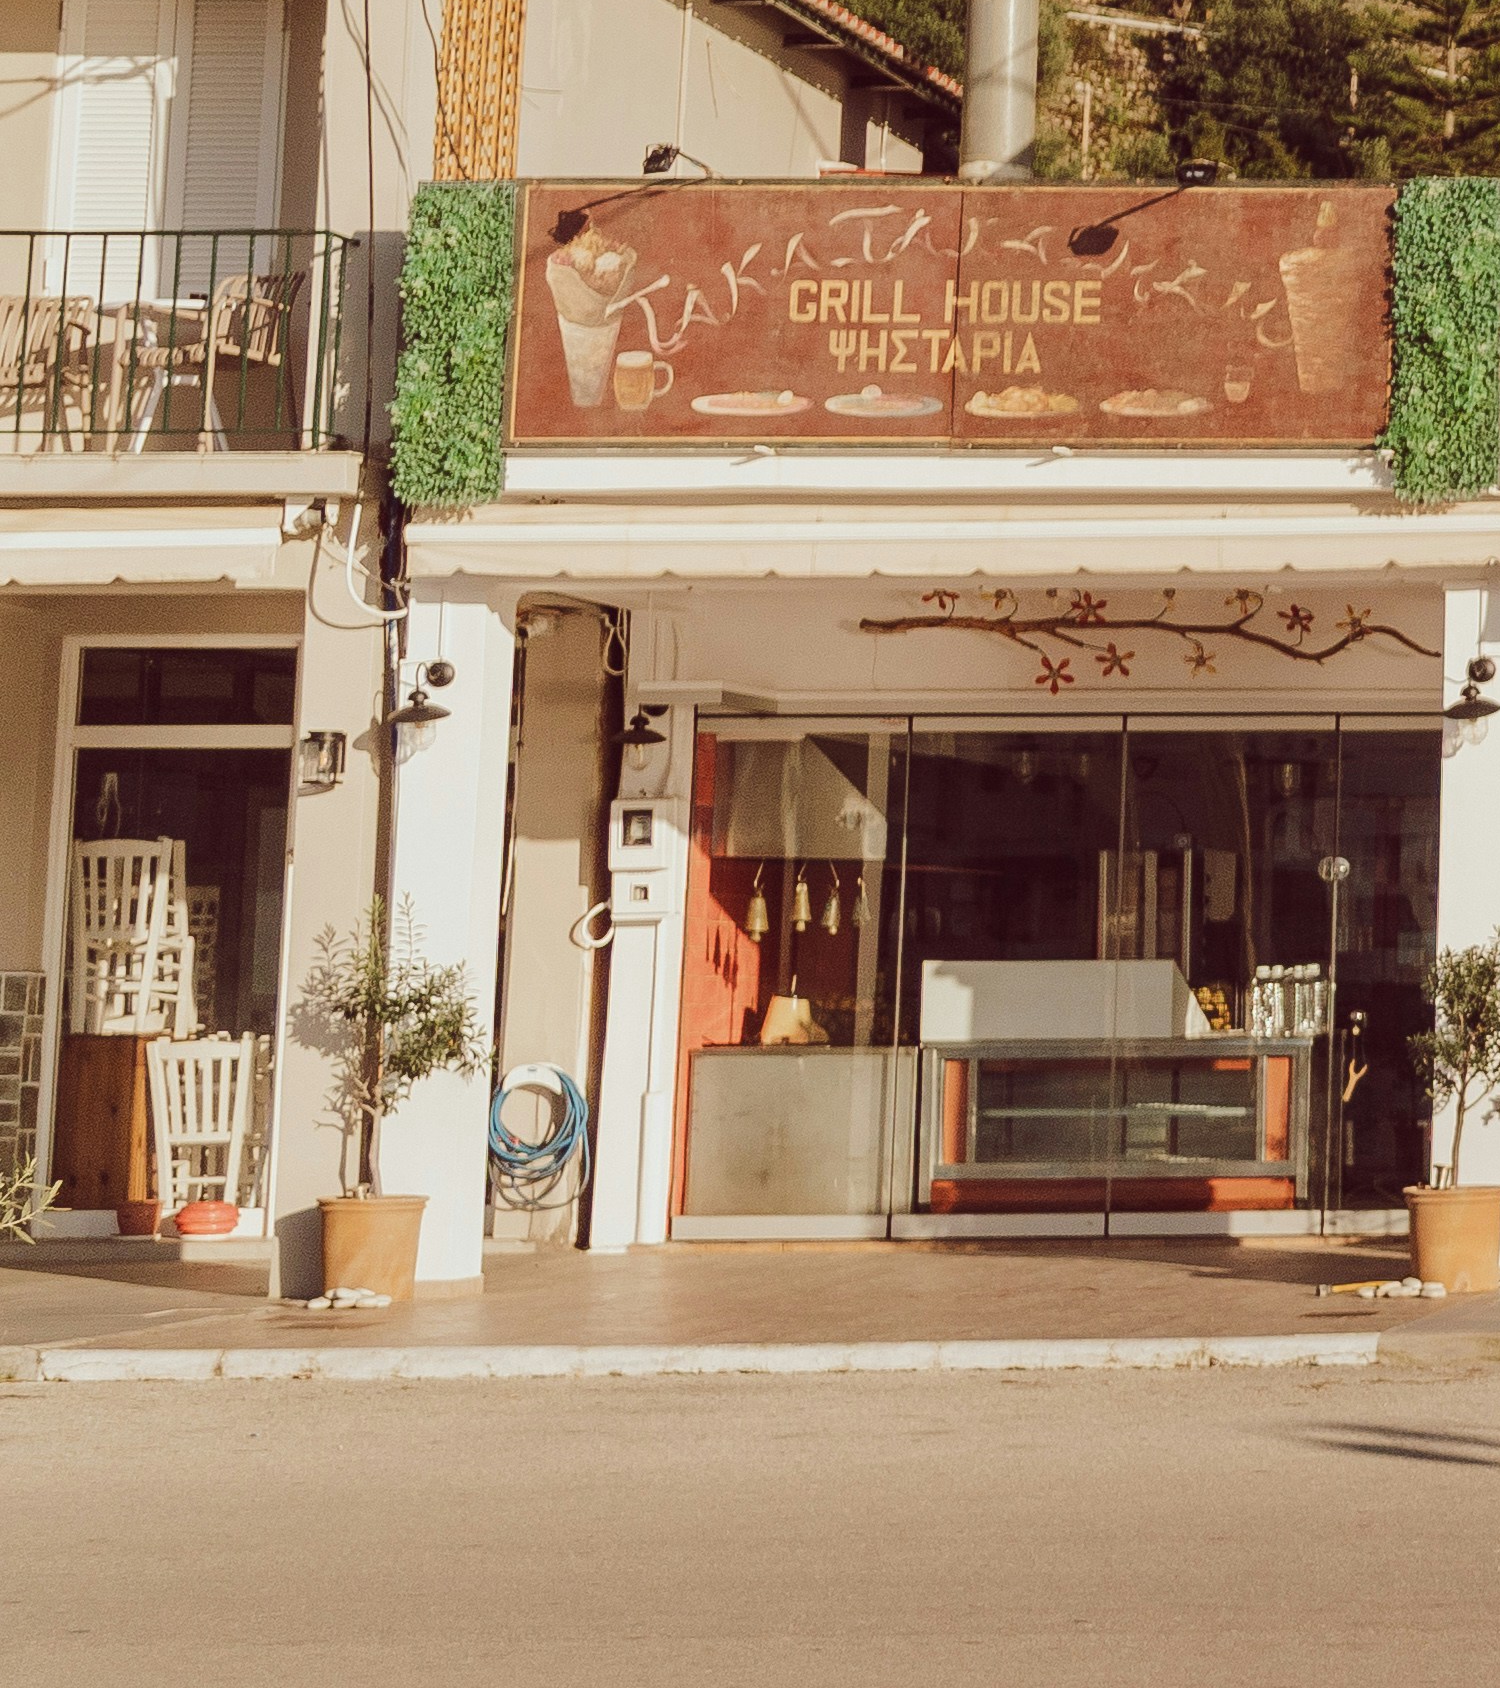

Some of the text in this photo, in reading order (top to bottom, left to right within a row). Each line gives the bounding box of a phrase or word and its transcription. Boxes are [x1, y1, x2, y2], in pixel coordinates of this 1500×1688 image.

[788, 278, 921, 325] GRILL
[944, 278, 1102, 326] HOUSE
[828, 328, 1042, 376] ΨΗΣΤΑΡΙΑ
